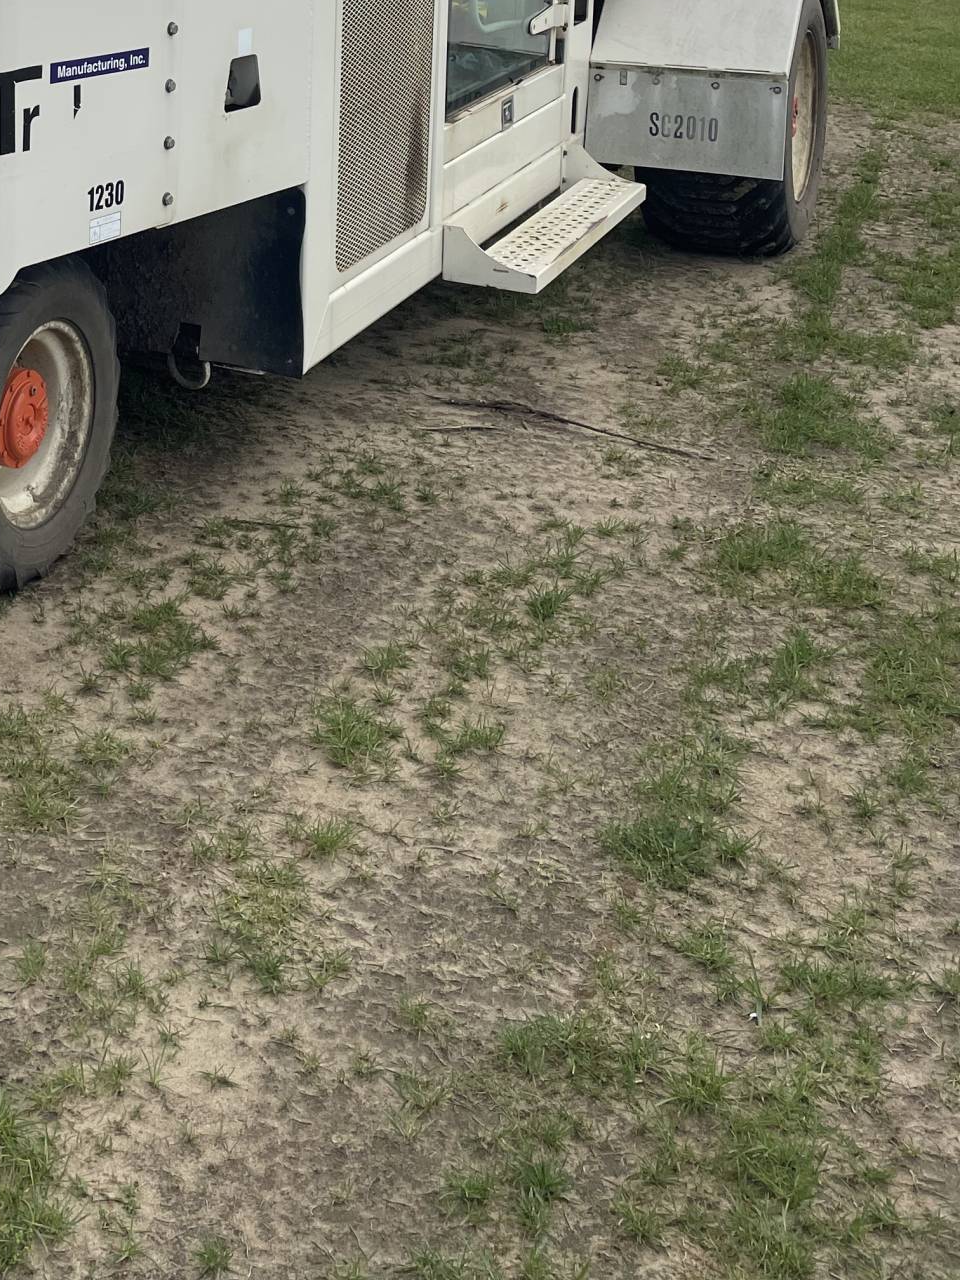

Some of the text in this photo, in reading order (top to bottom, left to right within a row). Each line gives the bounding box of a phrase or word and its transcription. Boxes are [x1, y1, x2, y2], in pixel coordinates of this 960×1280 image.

[57, 54, 146, 79] Manufacturing, Inc.
[648, 111, 719, 142] SC2010
[87, 179, 125, 212] 1230
